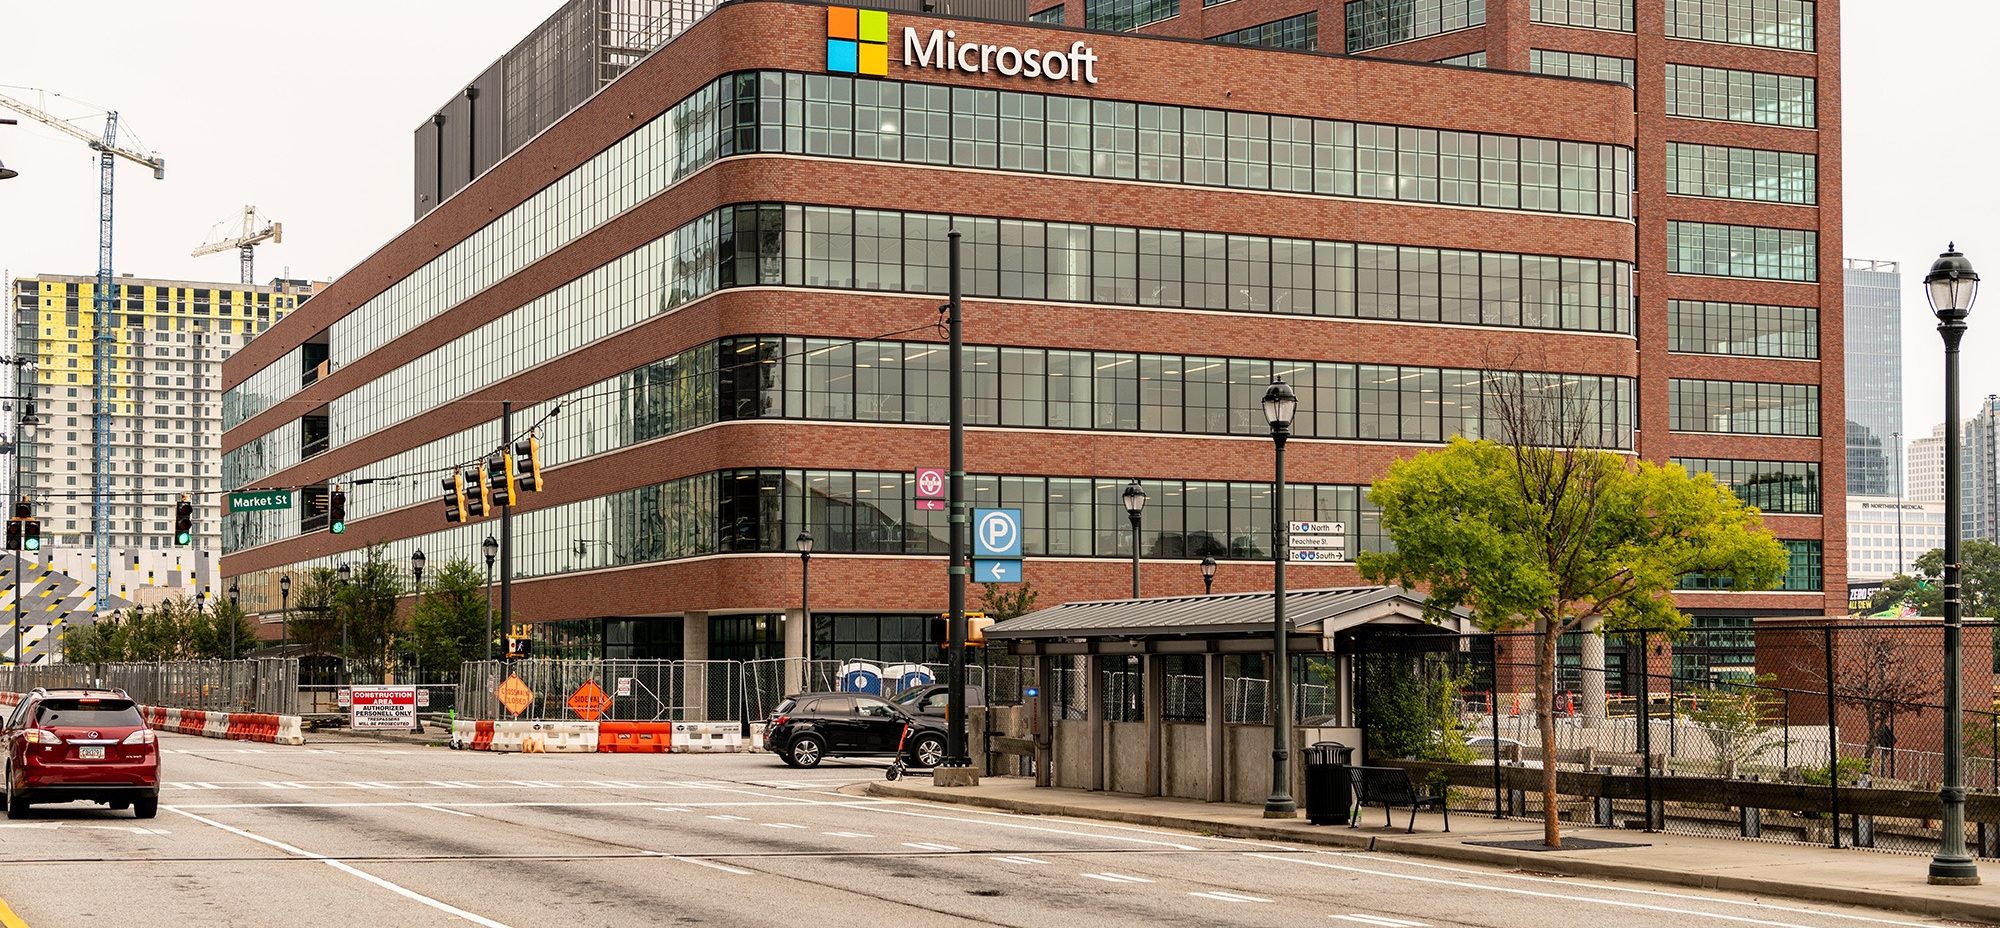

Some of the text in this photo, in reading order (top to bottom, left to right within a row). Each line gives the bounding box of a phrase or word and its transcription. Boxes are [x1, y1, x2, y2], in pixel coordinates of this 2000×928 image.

[903, 26, 1098, 84] Microsoft
[233, 495, 287, 507] Market St
[989, 518, 1009, 546] P
[1849, 588, 1867, 600] ZERO
[1857, 599, 1873, 609] DEW
[501, 688, 529, 696] COSSWALK
